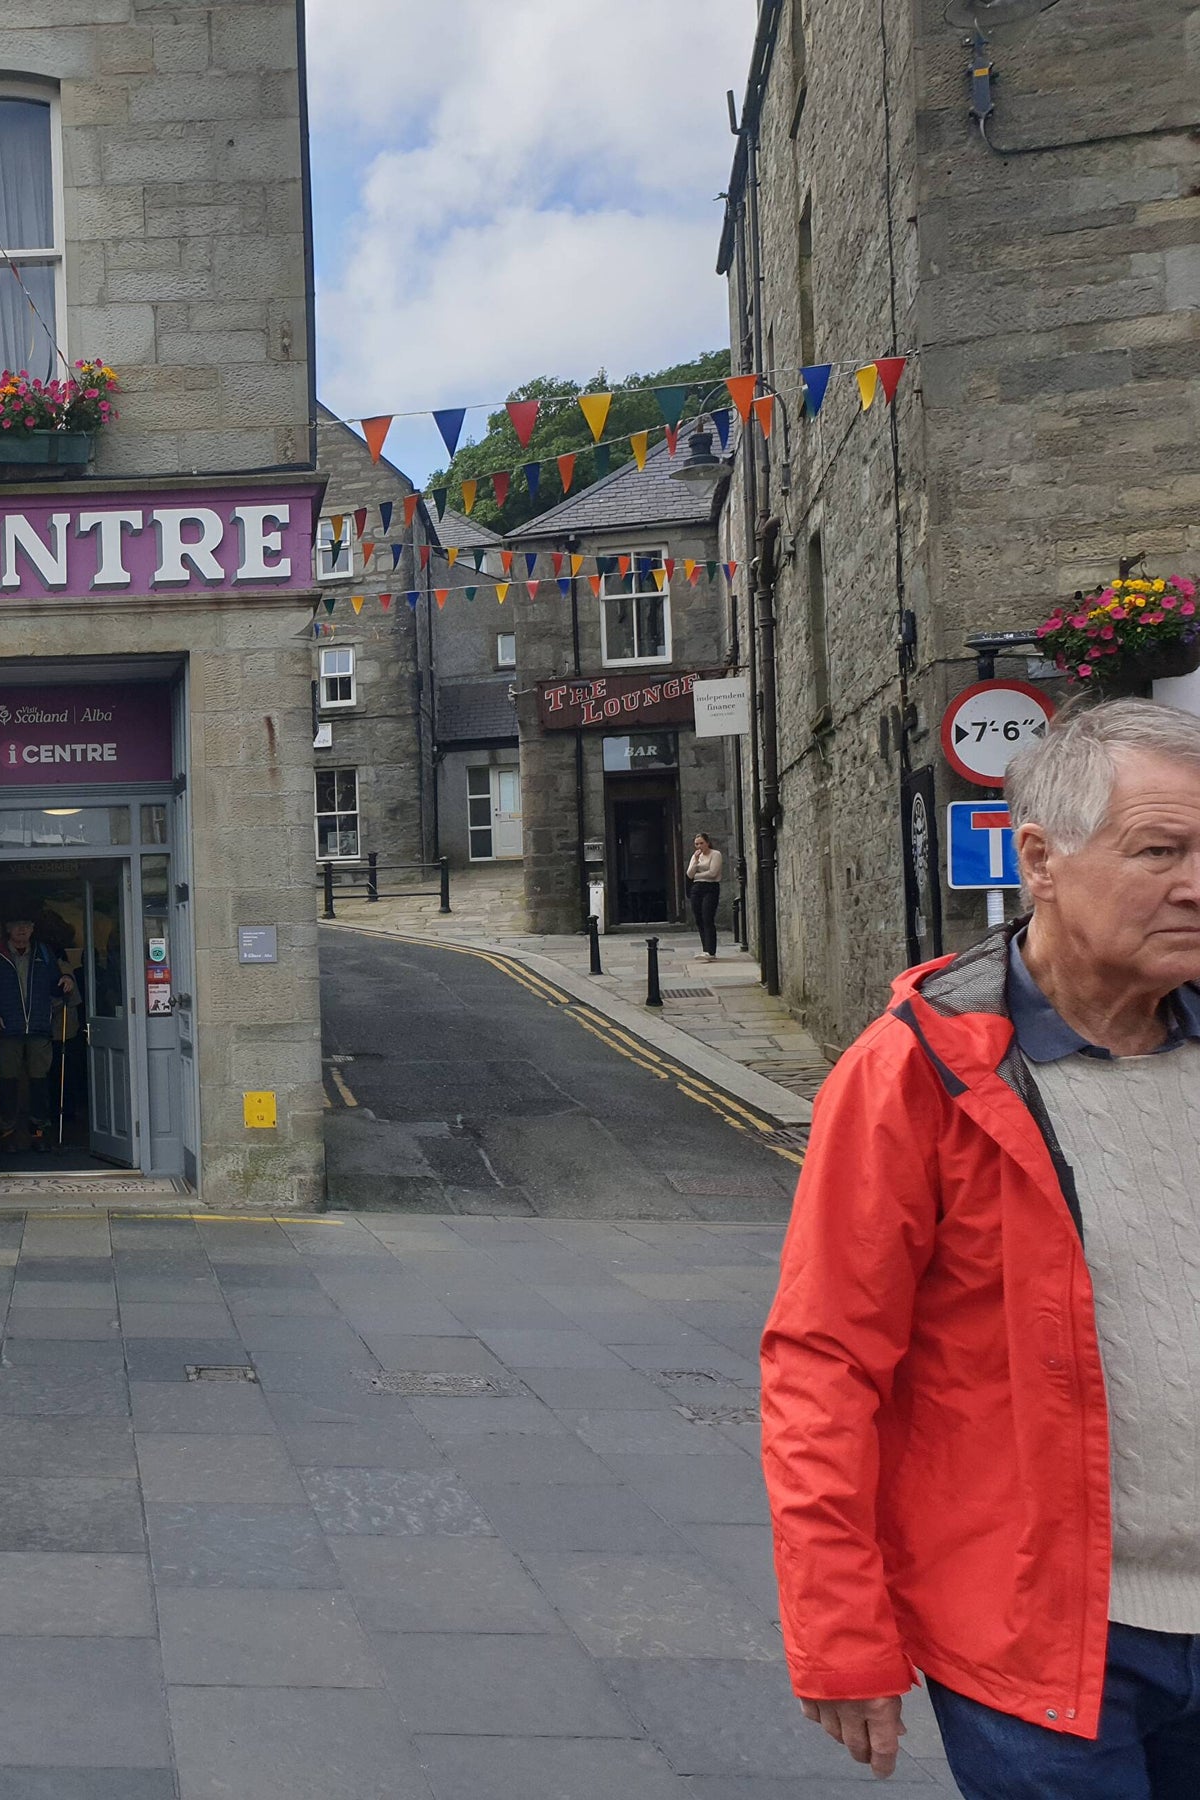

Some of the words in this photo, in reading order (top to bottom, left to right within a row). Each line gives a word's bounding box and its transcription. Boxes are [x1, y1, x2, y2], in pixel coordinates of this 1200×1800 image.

[544, 678, 607, 712] THE
[581, 673, 698, 725] LOUNGE
[696, 692, 745, 702] independent
[14, 709, 68, 723] Scotland
[81, 708, 112, 721] Alba
[21, 705, 38, 713] Visit
[22, 743, 117, 763] CENTRE
[623, 745, 659, 757] BAR
